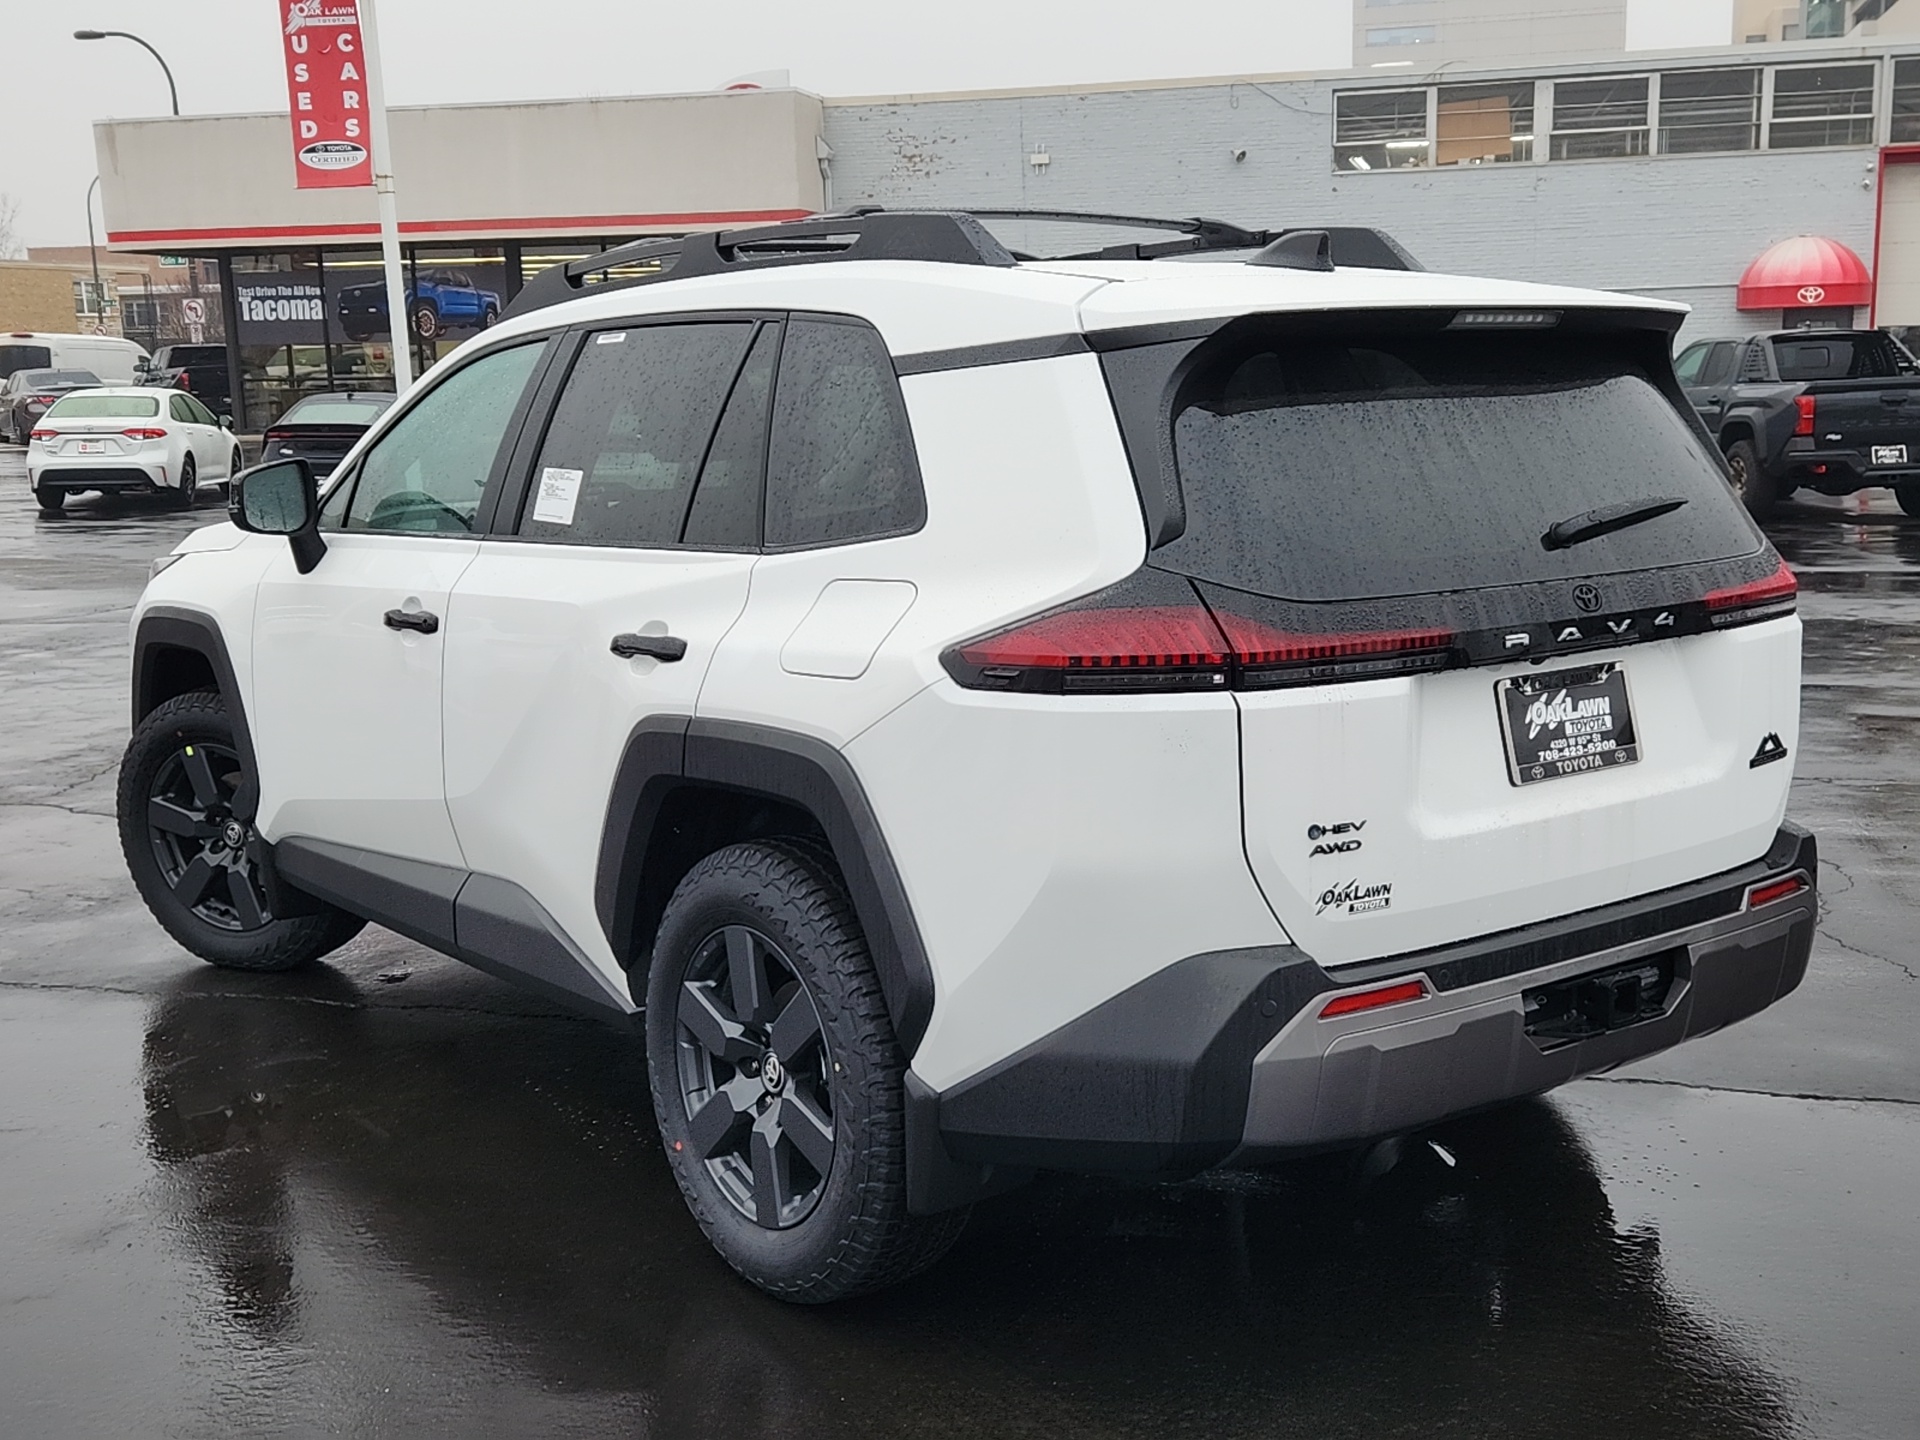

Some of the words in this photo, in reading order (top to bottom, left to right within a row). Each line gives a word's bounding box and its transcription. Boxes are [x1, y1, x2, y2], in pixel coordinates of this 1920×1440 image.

[295, 3, 322, 17] OAK
[325, 6, 355, 15] LAWN
[291, 35, 318, 139] USED
[337, 33, 360, 137] CARS
[310, 153, 359, 164] CERTIFIED
[237, 286, 254, 297] Test
[256, 286, 276, 297] Drive
[277, 286, 292, 296] The
[293, 285, 304, 296] All
[305, 285, 325, 296] New
[238, 296, 328, 321] Tacoma
[1504, 611, 1676, 649] RAV4
[1569, 718, 1608, 734] TOYOTA
[1537, 739, 1617, 762] 708-423-5200
[1550, 739, 1567, 749] 4320
[1568, 738, 1576, 748] W
[1592, 733, 1602, 743] St
[1555, 755, 1603, 774] TOYOTA
[1308, 839, 1362, 858] AWD
[1353, 898, 1387, 912] TOYOTA
